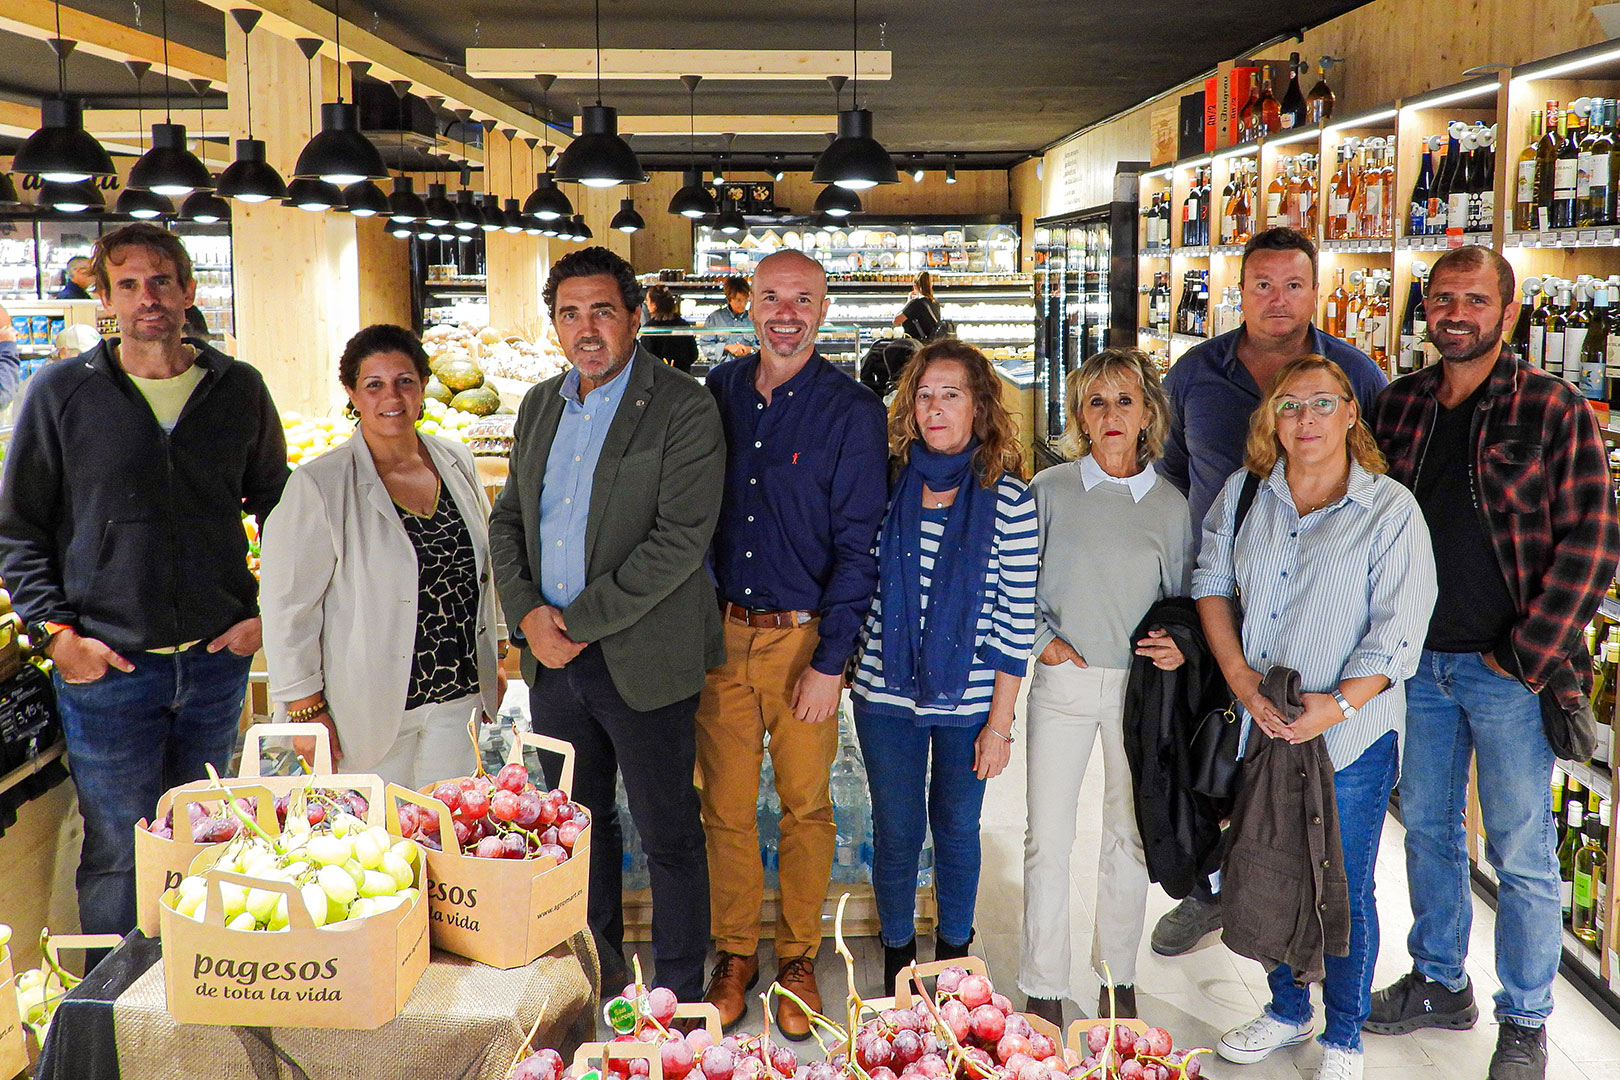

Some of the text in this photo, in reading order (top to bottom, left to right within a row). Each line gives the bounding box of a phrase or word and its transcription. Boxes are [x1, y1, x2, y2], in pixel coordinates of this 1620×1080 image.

[1207, 105, 1216, 126] AN/2
[428, 880, 477, 907] esos
[447, 912, 480, 932] vida
[193, 953, 339, 985] pagesos
[196, 982, 343, 1002] de tota la vida
